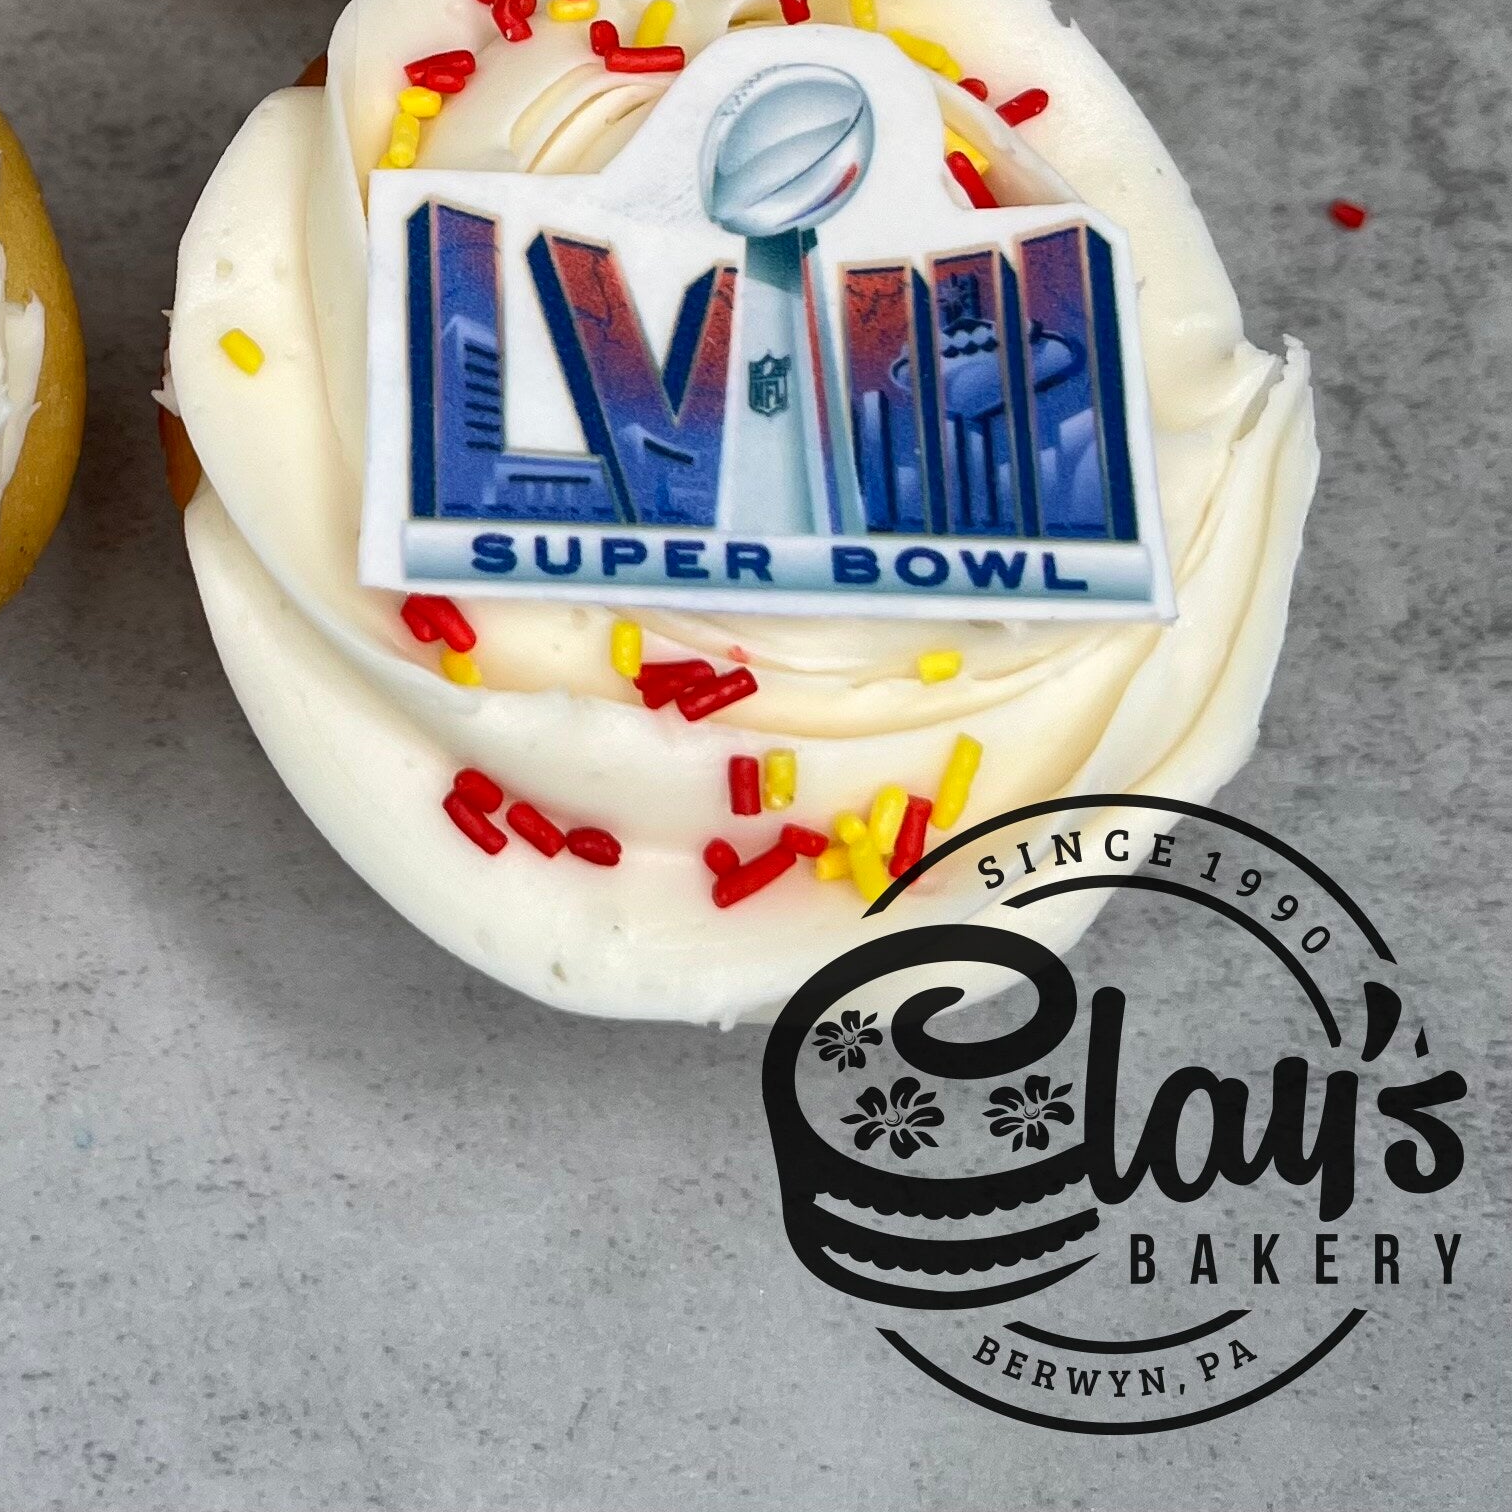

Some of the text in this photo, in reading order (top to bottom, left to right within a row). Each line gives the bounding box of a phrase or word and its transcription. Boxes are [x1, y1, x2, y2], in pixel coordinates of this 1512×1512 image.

[404, 195, 1138, 541] LVIII
[471, 532, 1088, 593] SUPER BOWL
